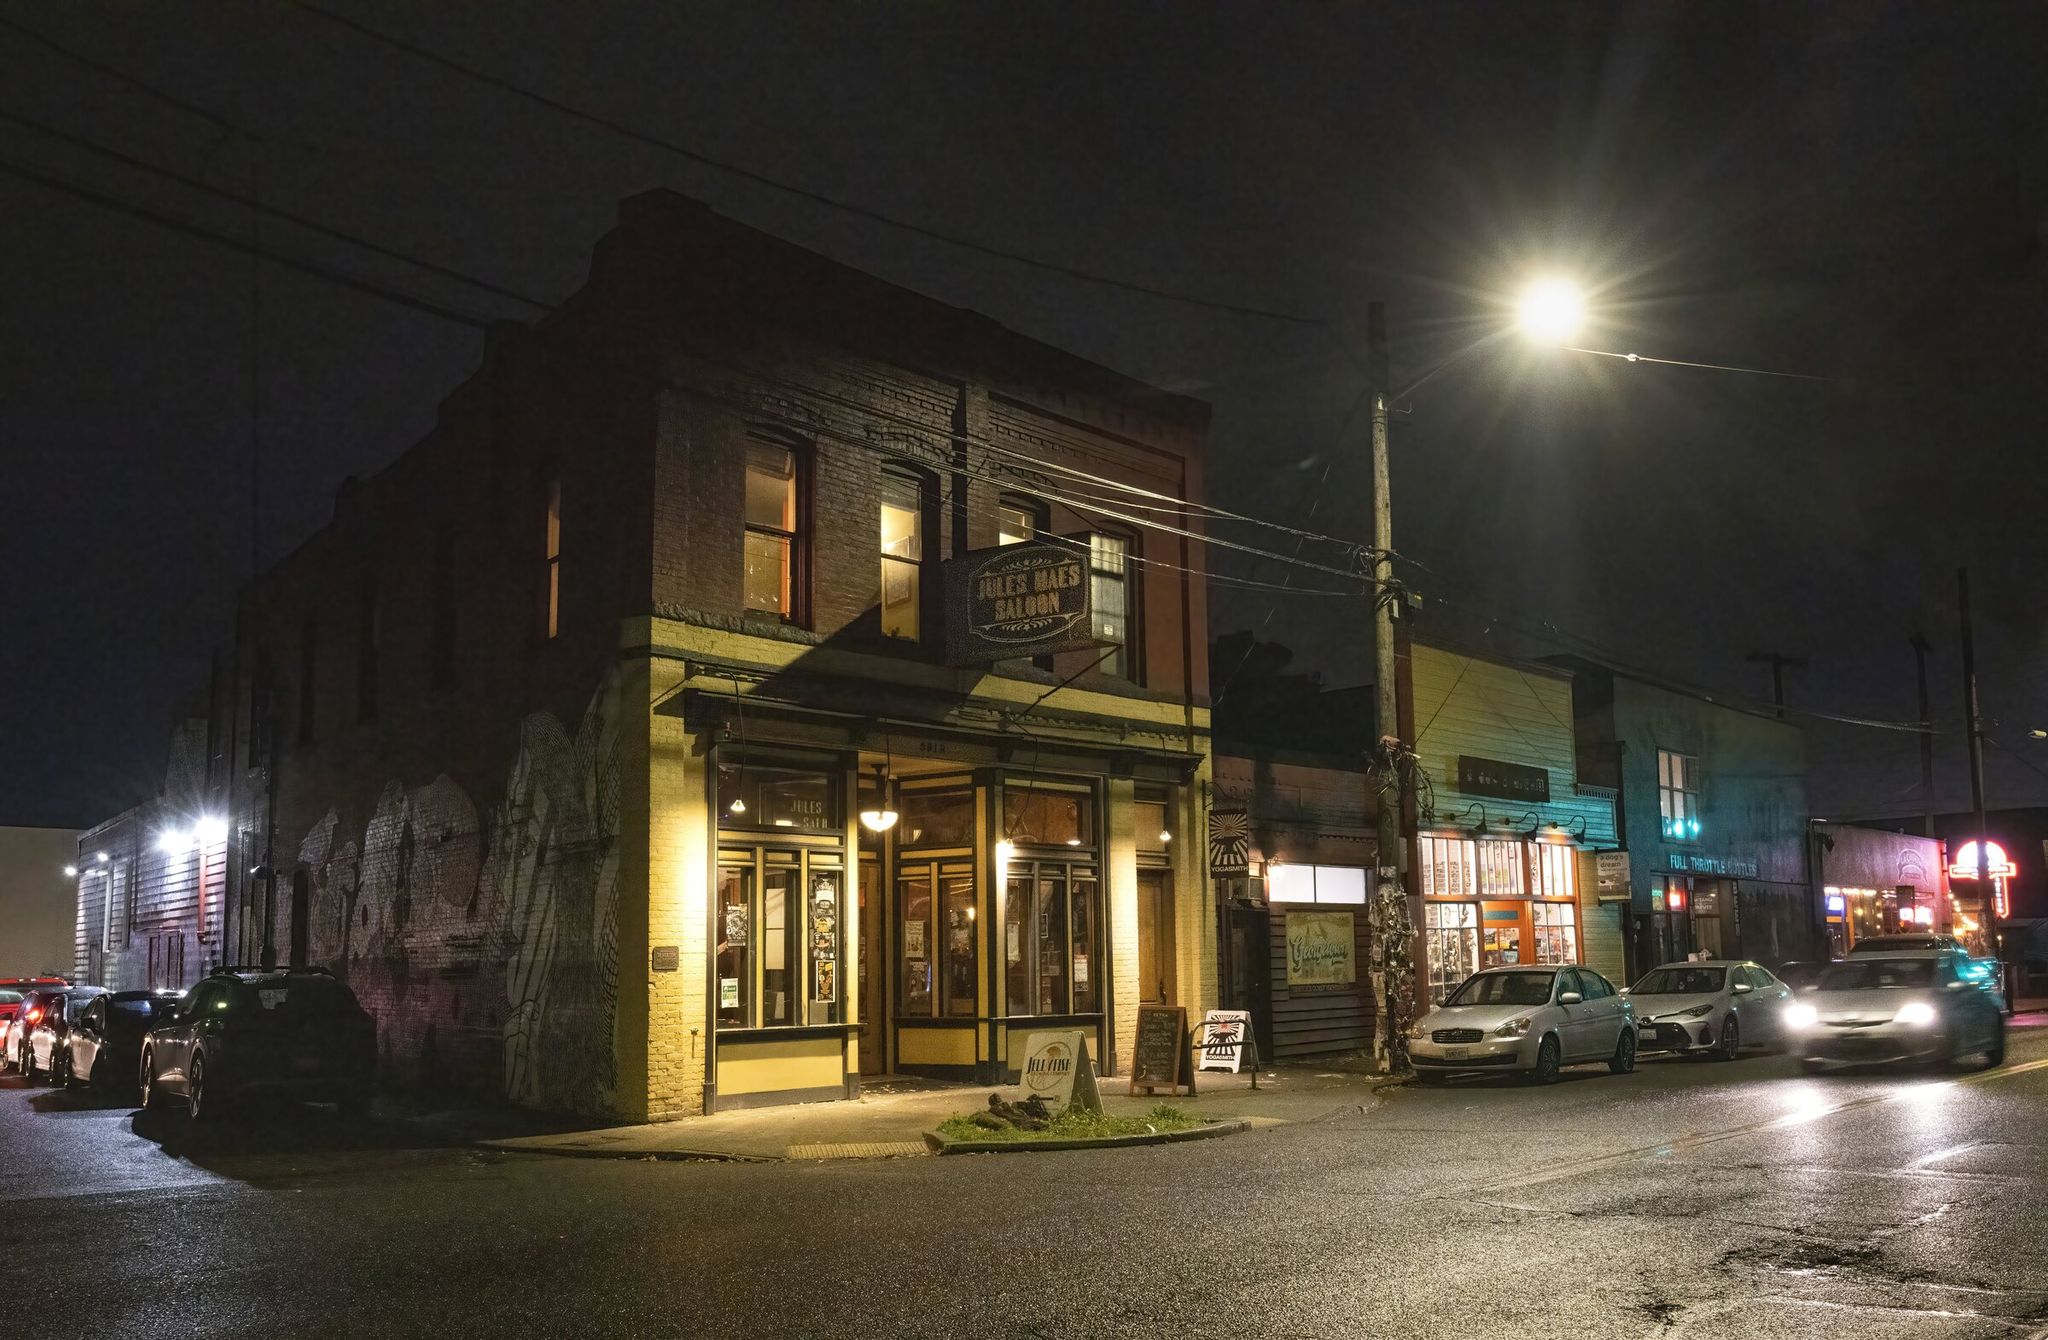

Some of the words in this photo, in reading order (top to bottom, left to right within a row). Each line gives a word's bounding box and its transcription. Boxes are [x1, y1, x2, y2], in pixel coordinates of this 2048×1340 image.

[977, 573, 1028, 600] JULES
[995, 591, 1060, 621] SALOON
[791, 800, 822, 814] JULES
[1670, 854, 1688, 870] FULL
[1690, 857, 1725, 874] THROTTLE
